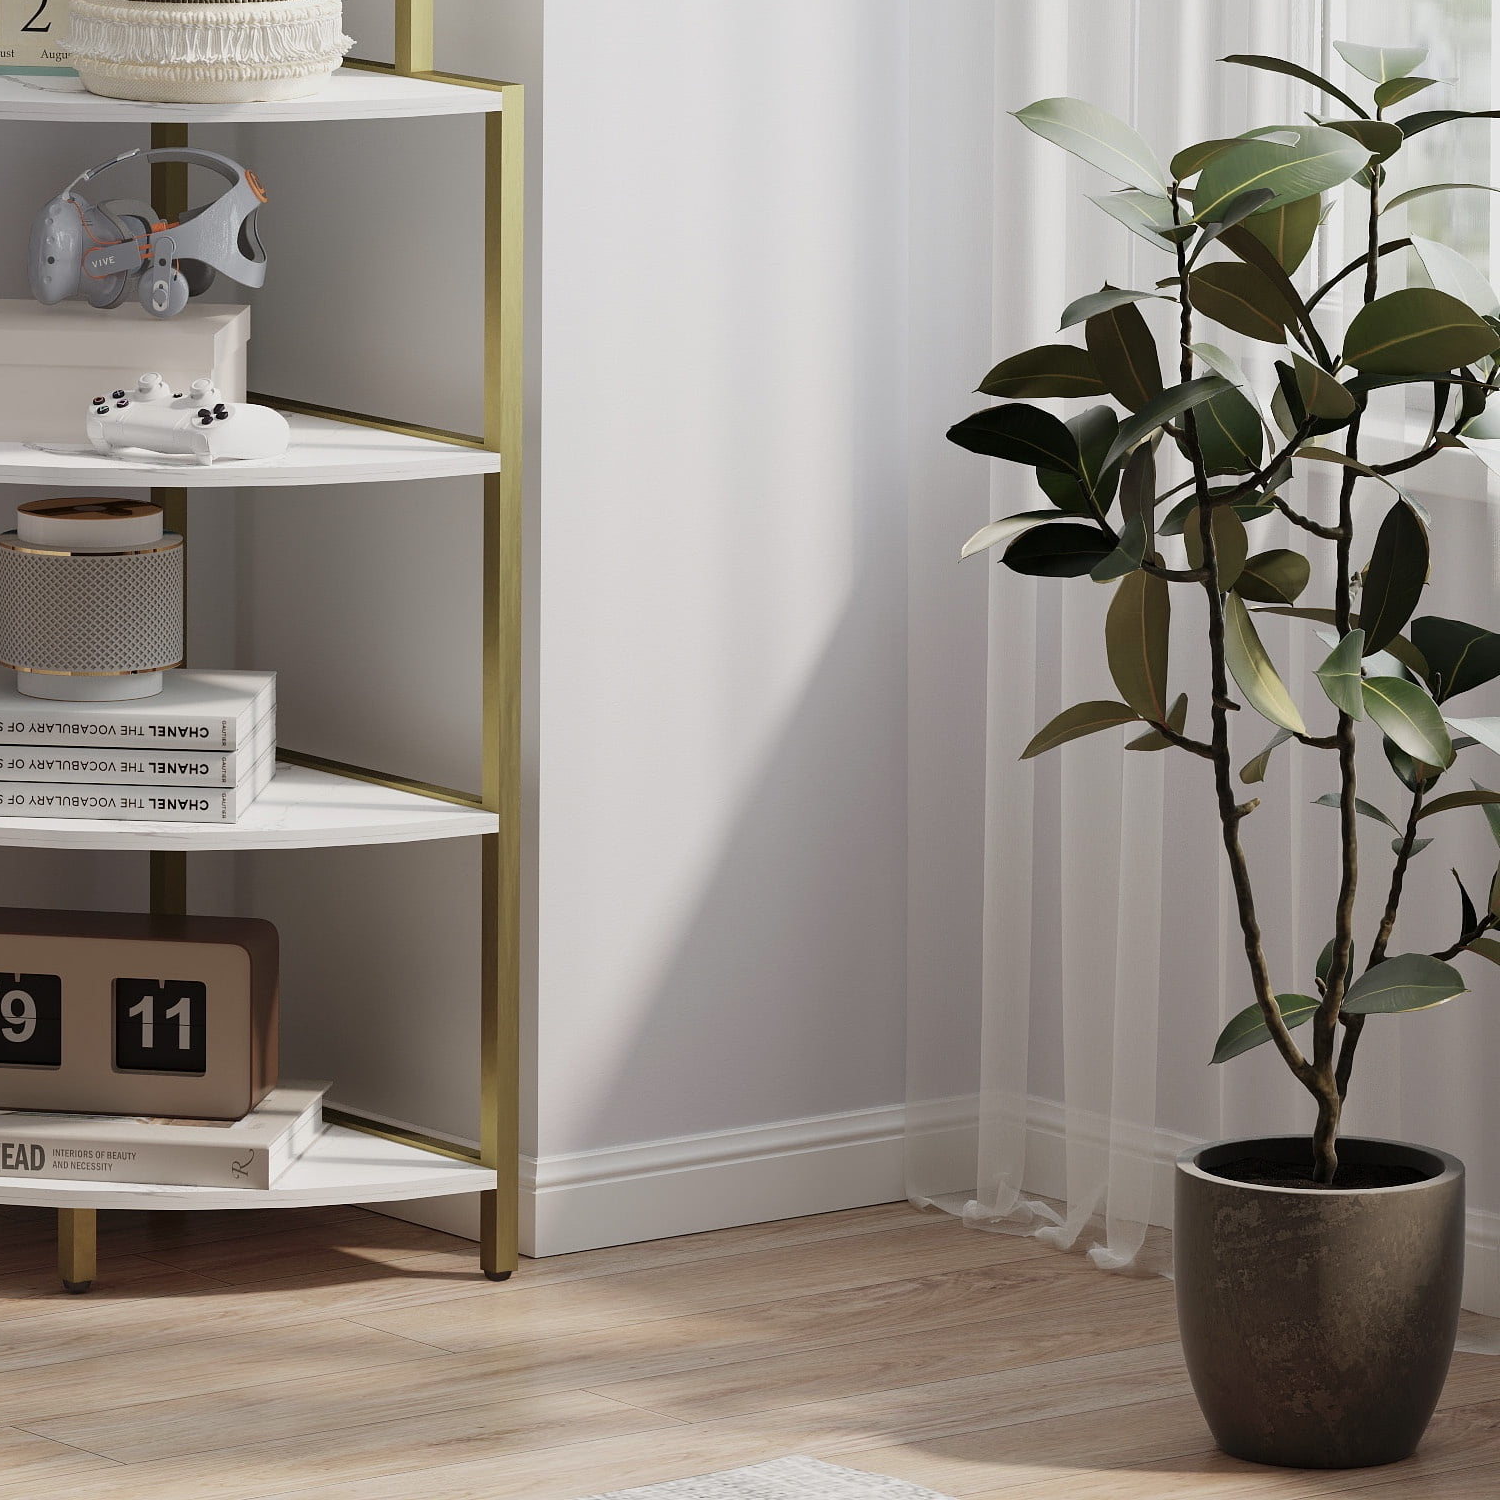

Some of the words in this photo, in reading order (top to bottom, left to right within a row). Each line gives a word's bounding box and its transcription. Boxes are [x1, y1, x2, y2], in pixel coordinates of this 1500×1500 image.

[91, 255, 116, 268] VIVE
[7, 722, 25, 734] OF
[28, 722, 117, 736] VOCABULARY
[120, 725, 145, 737] THE
[148, 725, 210, 739] CHANEL
[7, 758, 25, 770] OF
[28, 758, 117, 772] VOCABULARY
[120, 761, 145, 773] THE
[148, 761, 210, 775] CHANEL
[7, 794, 25, 806] OF
[28, 794, 117, 808] VOCABULARY
[120, 797, 145, 809] THE
[148, 797, 210, 811] CHANEL
[0, 989, 38, 1043] 9
[128, 995, 192, 1050] 11
[52, 1148, 94, 1159] INTERIORS
[95, 1150, 106, 1160] OF
[106, 1151, 137, 1161] BEAUTY
[52, 1160, 69, 1170] AND
[70, 1160, 113, 1172] NECESSITY
